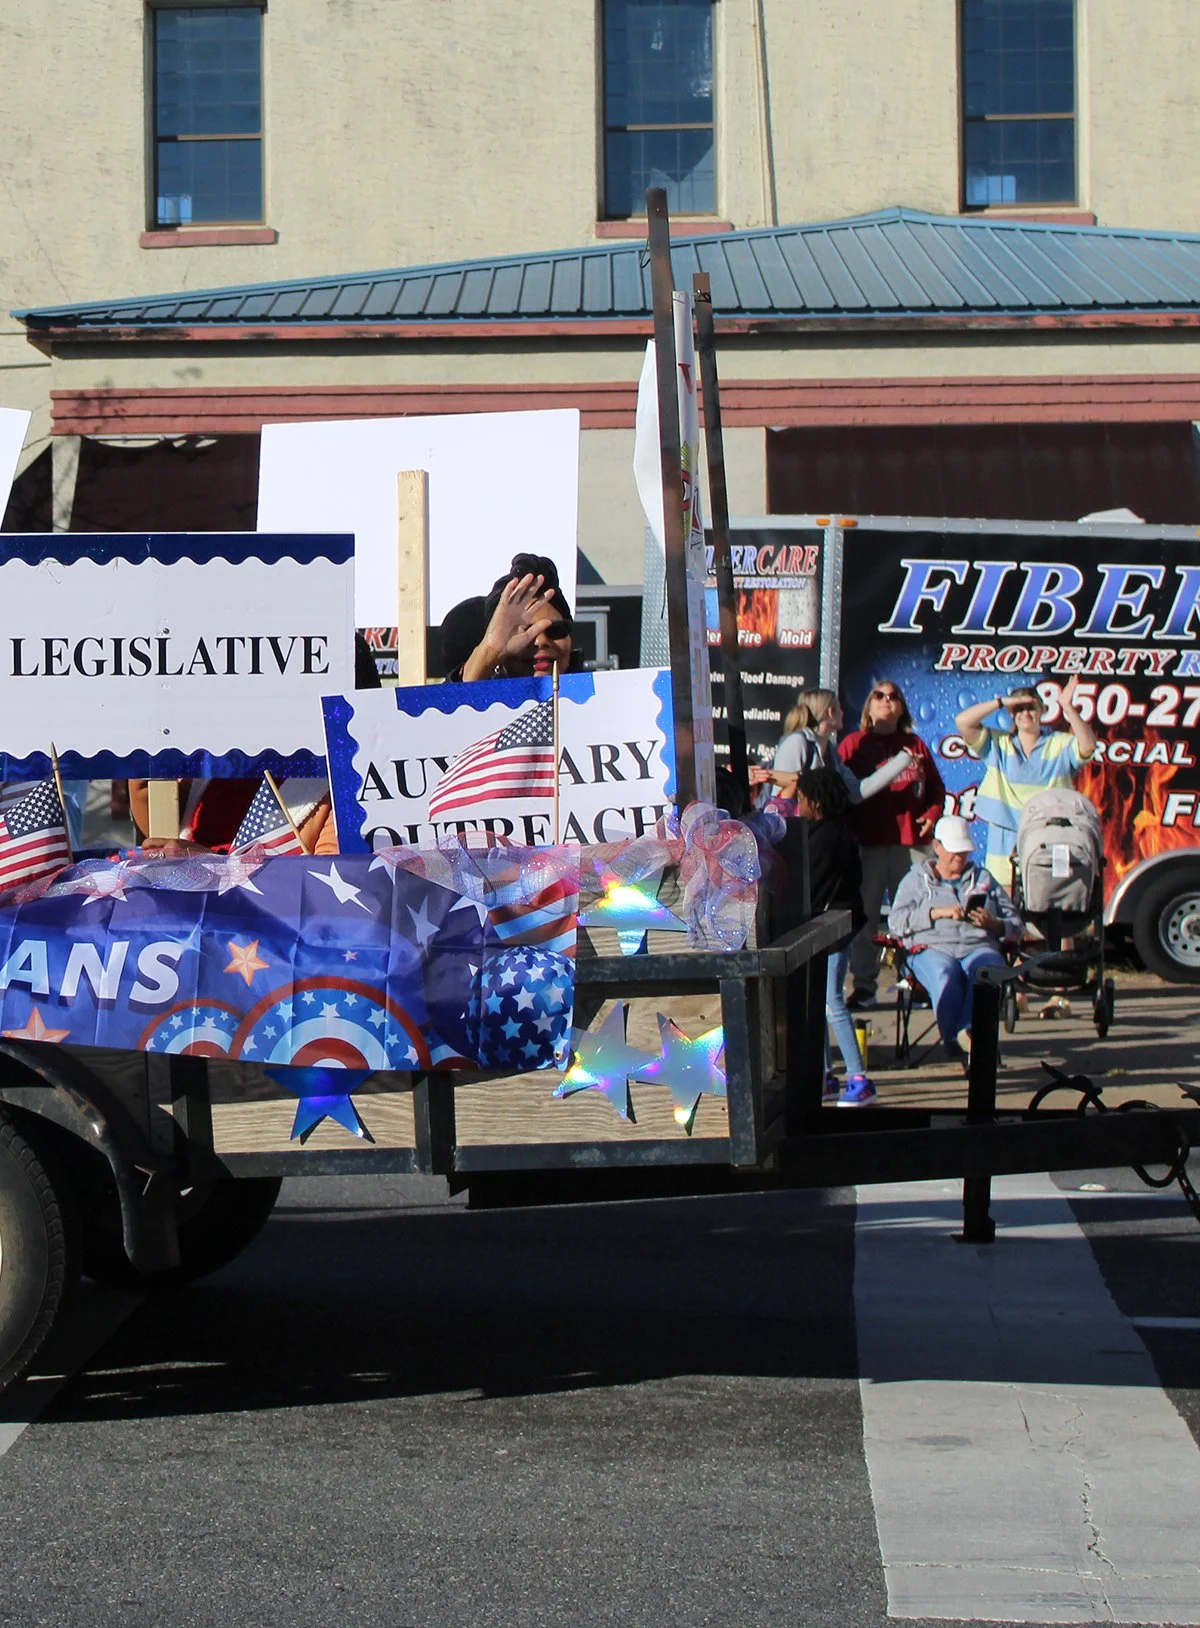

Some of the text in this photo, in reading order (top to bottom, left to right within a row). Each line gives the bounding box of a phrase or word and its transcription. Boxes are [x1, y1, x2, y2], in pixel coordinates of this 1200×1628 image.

[737, 630, 761, 644] Fire
[780, 630, 812, 645] Mold
[9, 635, 330, 677] LEGISLATIVE
[766, 672, 805, 688] Damage
[941, 735, 1193, 764] CRCIAL
[358, 739, 659, 802] AUARY
